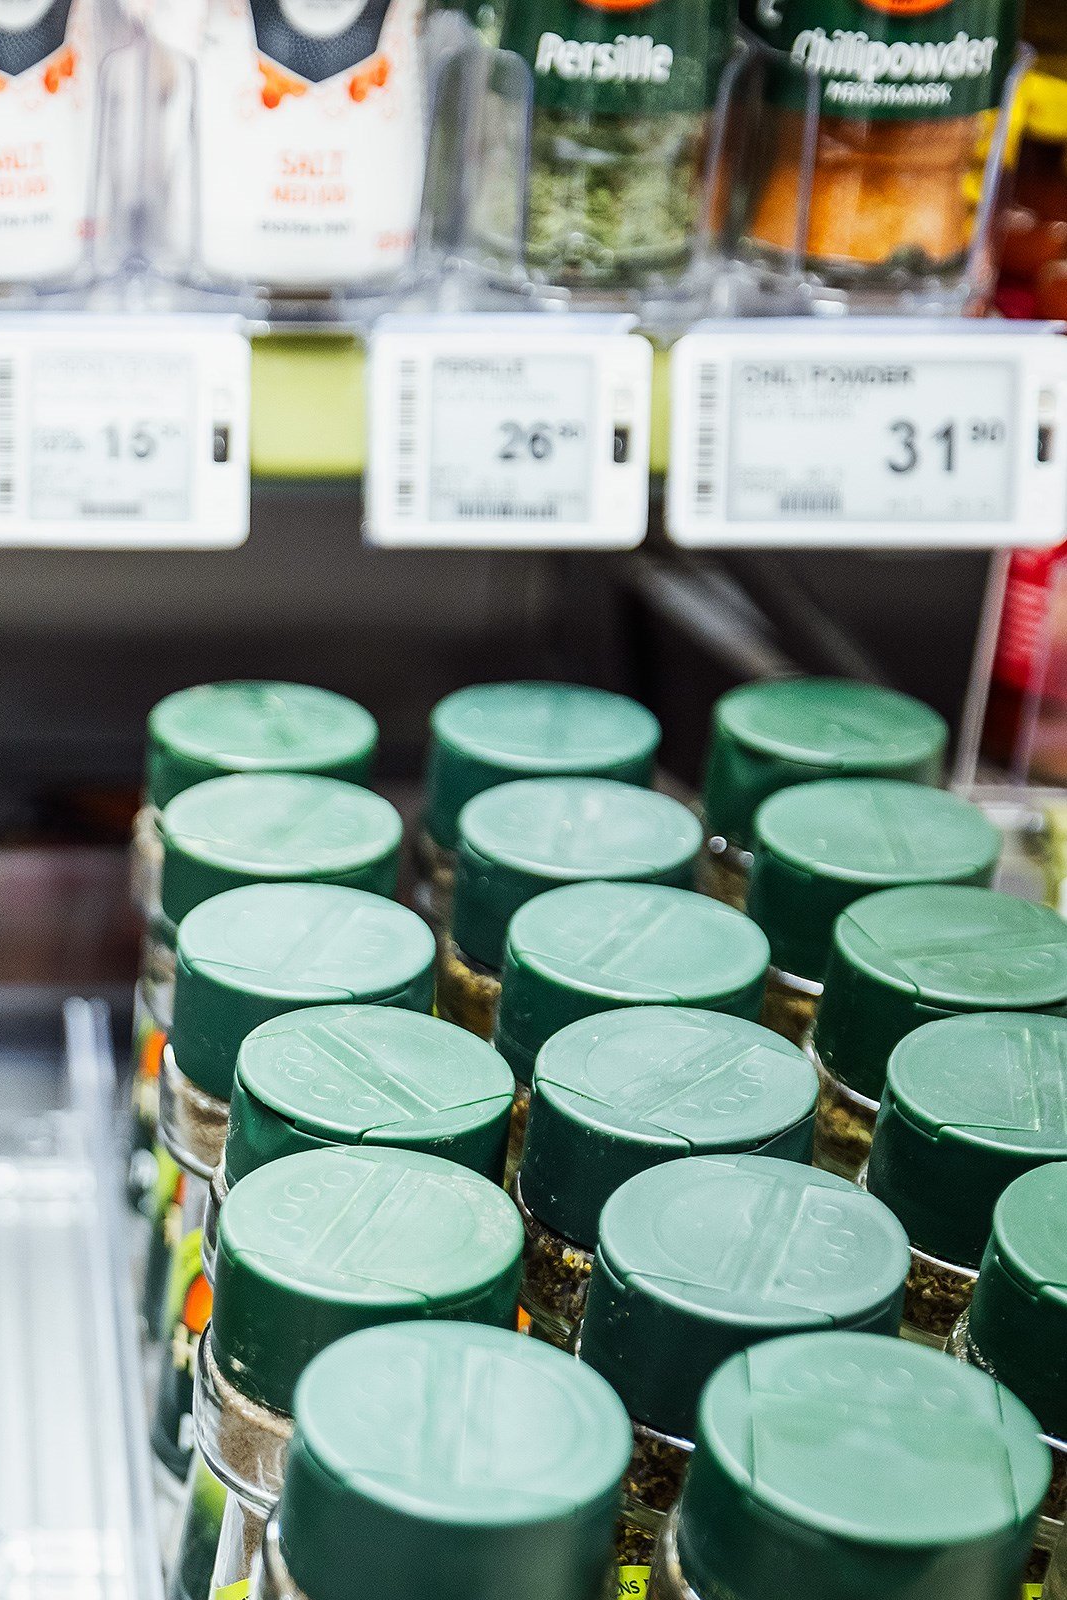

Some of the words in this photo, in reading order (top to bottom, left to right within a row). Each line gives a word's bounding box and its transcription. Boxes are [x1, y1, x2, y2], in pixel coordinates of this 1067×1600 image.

[535, 31, 674, 84] Persille
[498, 419, 554, 460] 26
[887, 417, 957, 474] 31
